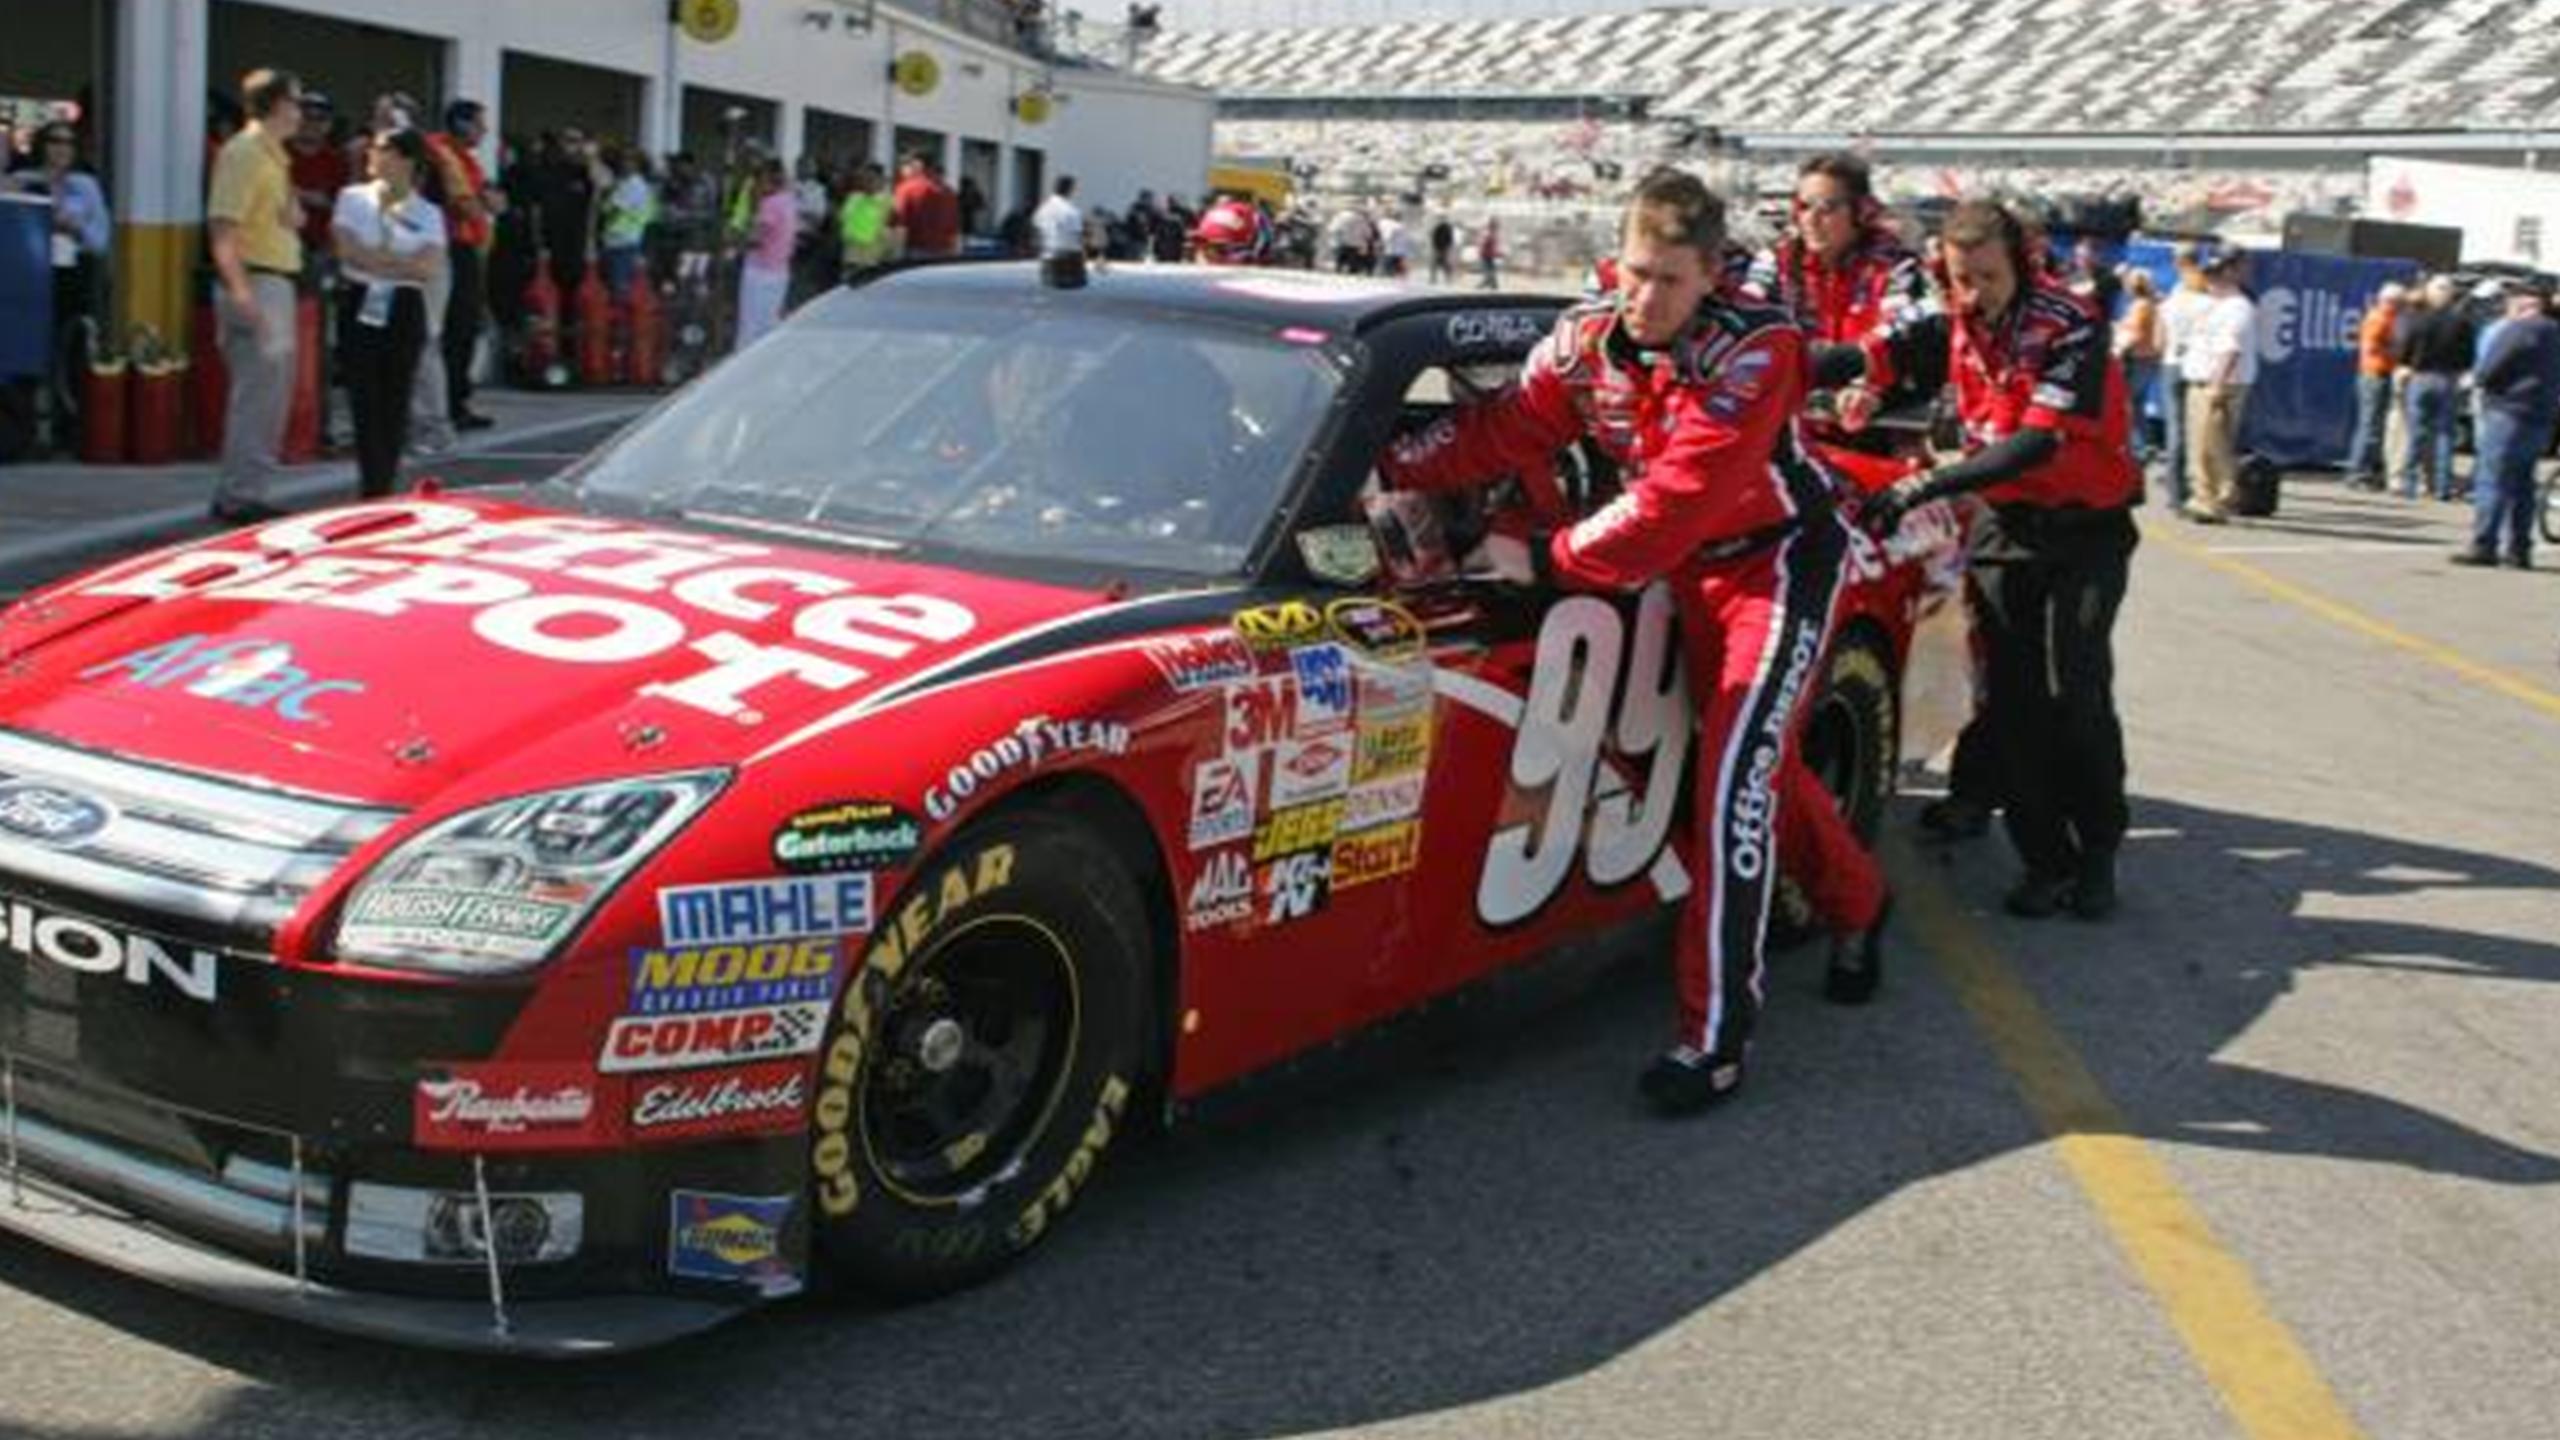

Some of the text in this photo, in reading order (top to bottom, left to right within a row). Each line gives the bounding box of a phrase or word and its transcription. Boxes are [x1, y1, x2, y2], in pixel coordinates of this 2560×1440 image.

[257, 500, 975, 659] Office
[80, 548, 870, 717] DEPOT
[1230, 678, 1298, 748] 3M
[1477, 580, 1690, 926] 99
[1733, 619, 1820, 879] Office DEPOT
[1201, 758, 1250, 814] EA
[776, 822, 919, 859] Gatorback
[668, 880, 867, 940] MAHLE
[637, 938, 834, 991] MOOG
[613, 1013, 775, 1058] COMP
[813, 843, 1015, 1216] GOODYEAR
[633, 1073, 803, 1126] Edelbrock
[1010, 1074, 1129, 1246] EAGLE
